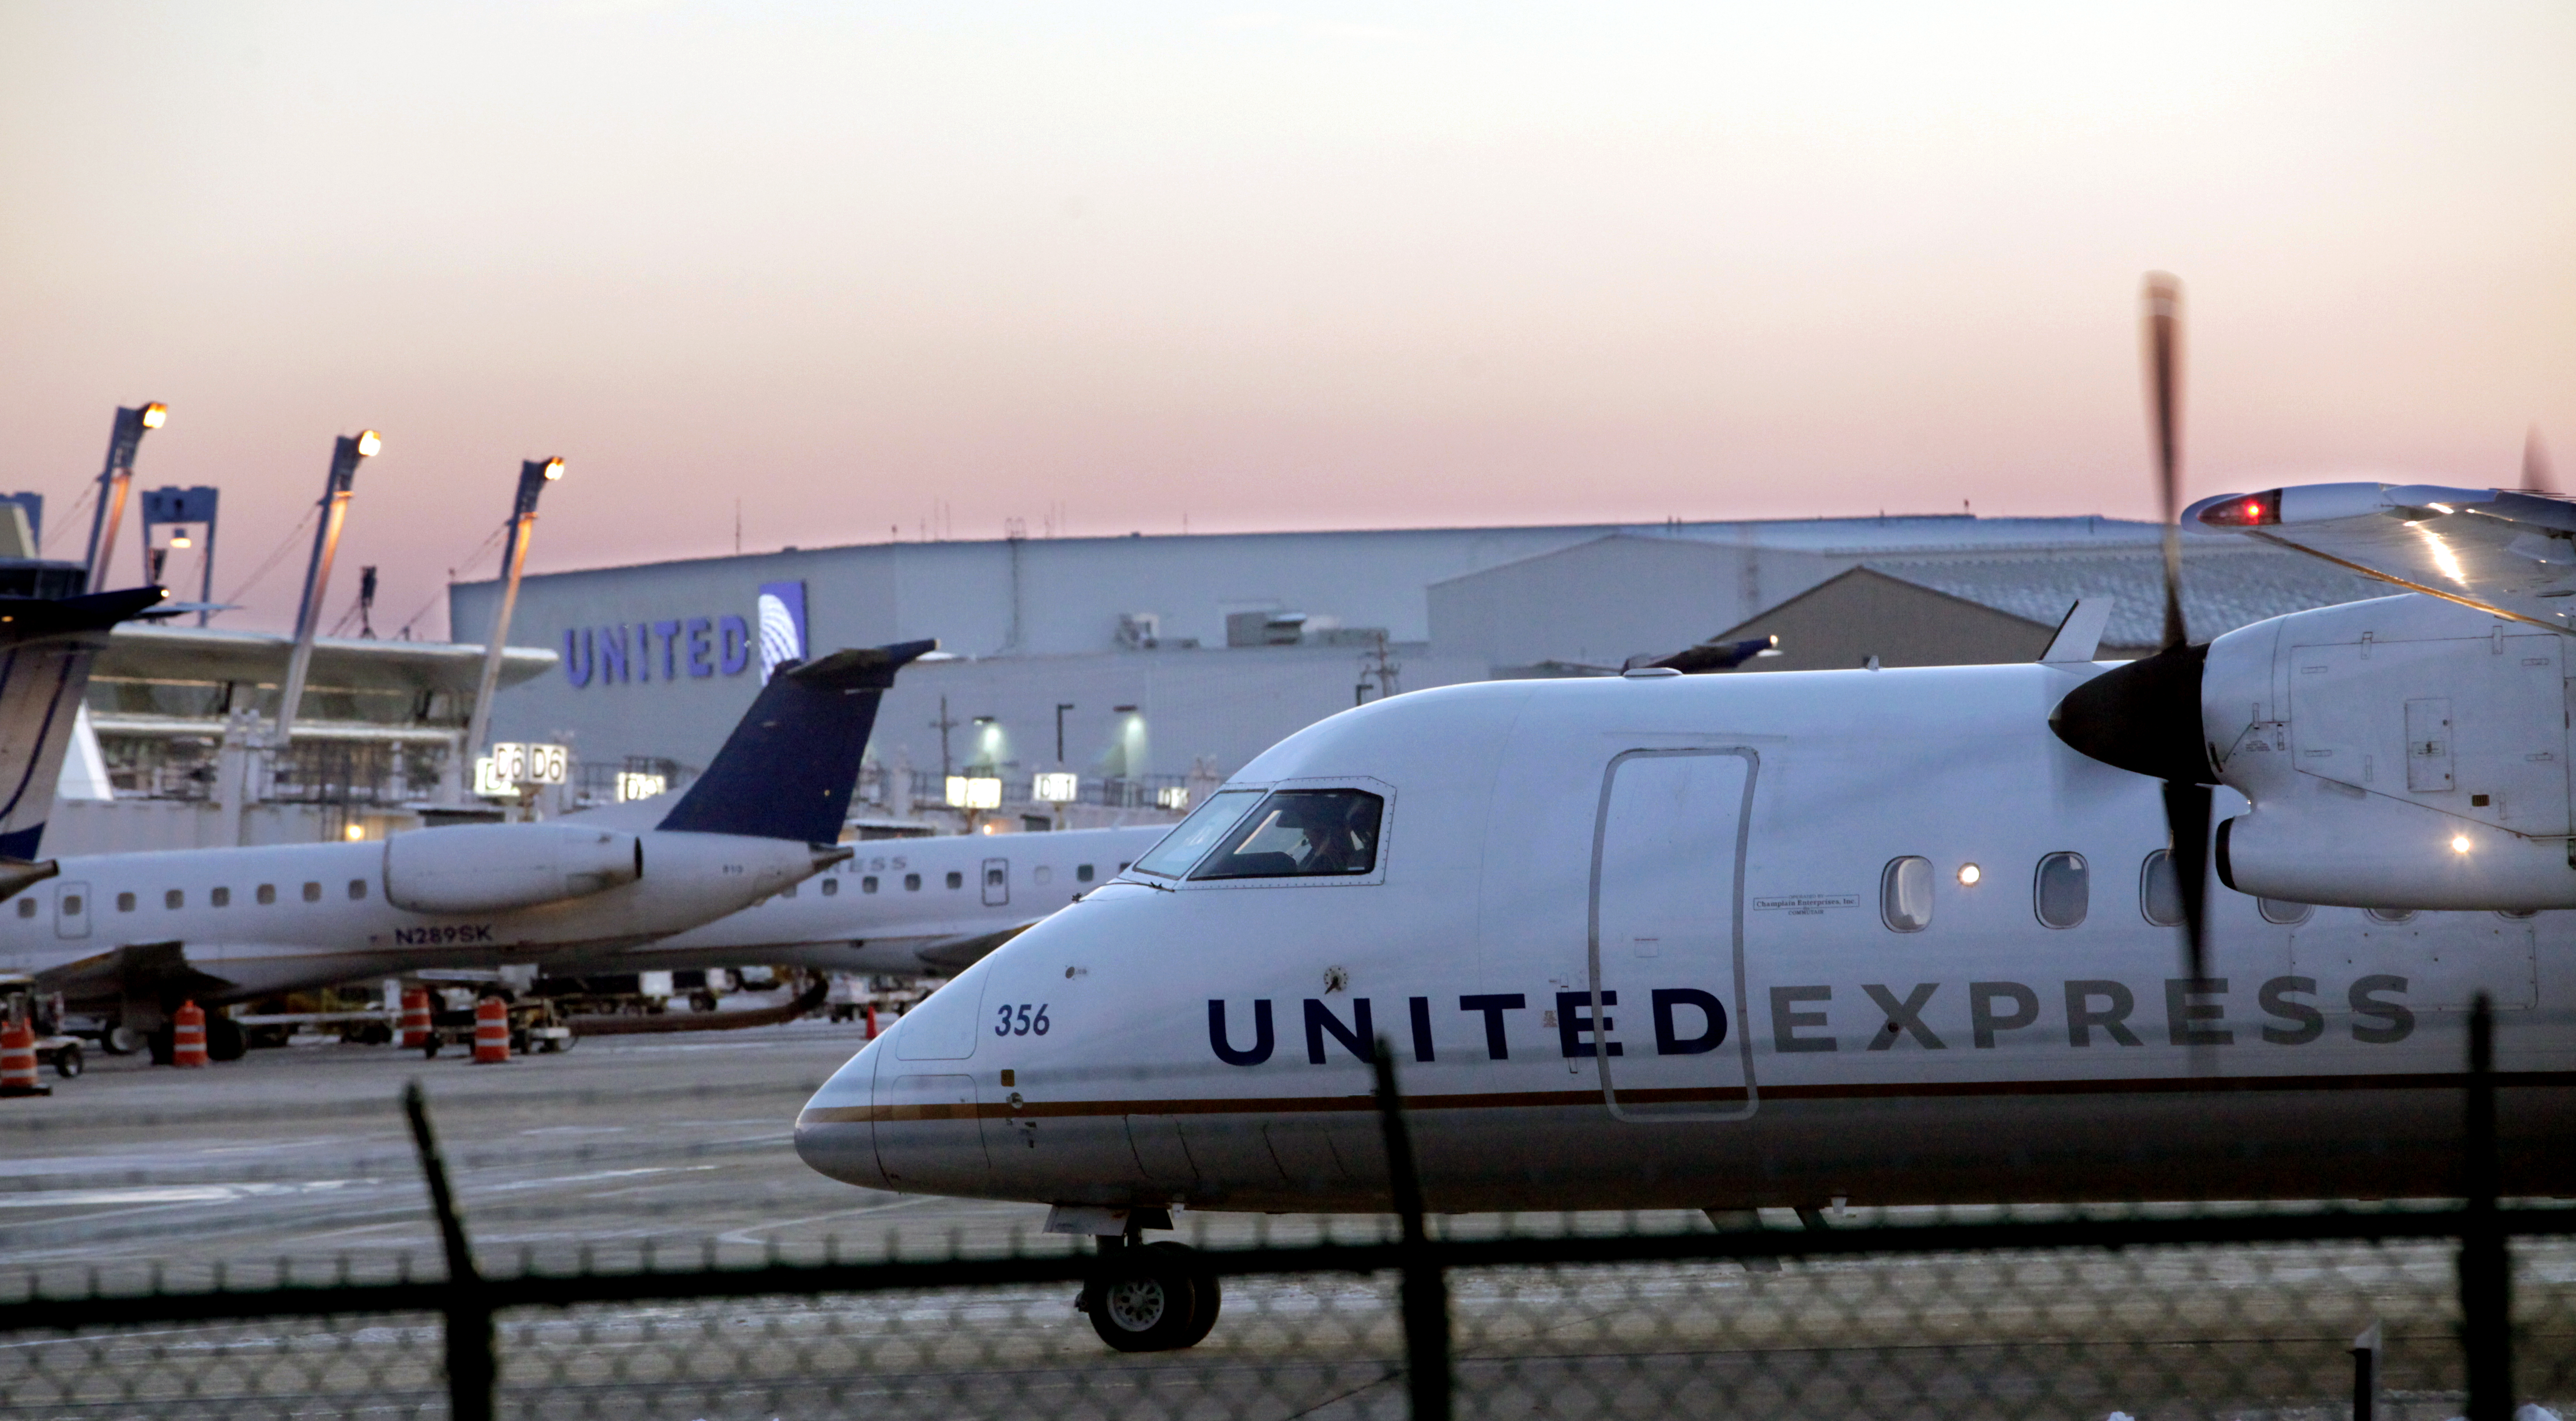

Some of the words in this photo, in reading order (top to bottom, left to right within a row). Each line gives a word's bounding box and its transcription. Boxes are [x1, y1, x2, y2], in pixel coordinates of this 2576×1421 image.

[564, 616, 748, 687] UNITED
[496, 748, 523, 778] D6
[533, 748, 562, 780] D6
[395, 924, 493, 944] N289SK
[995, 1005, 1050, 1036] 356
[1208, 988, 1727, 1066] UNITED
[1770, 975, 2415, 1053] EXPRESS
